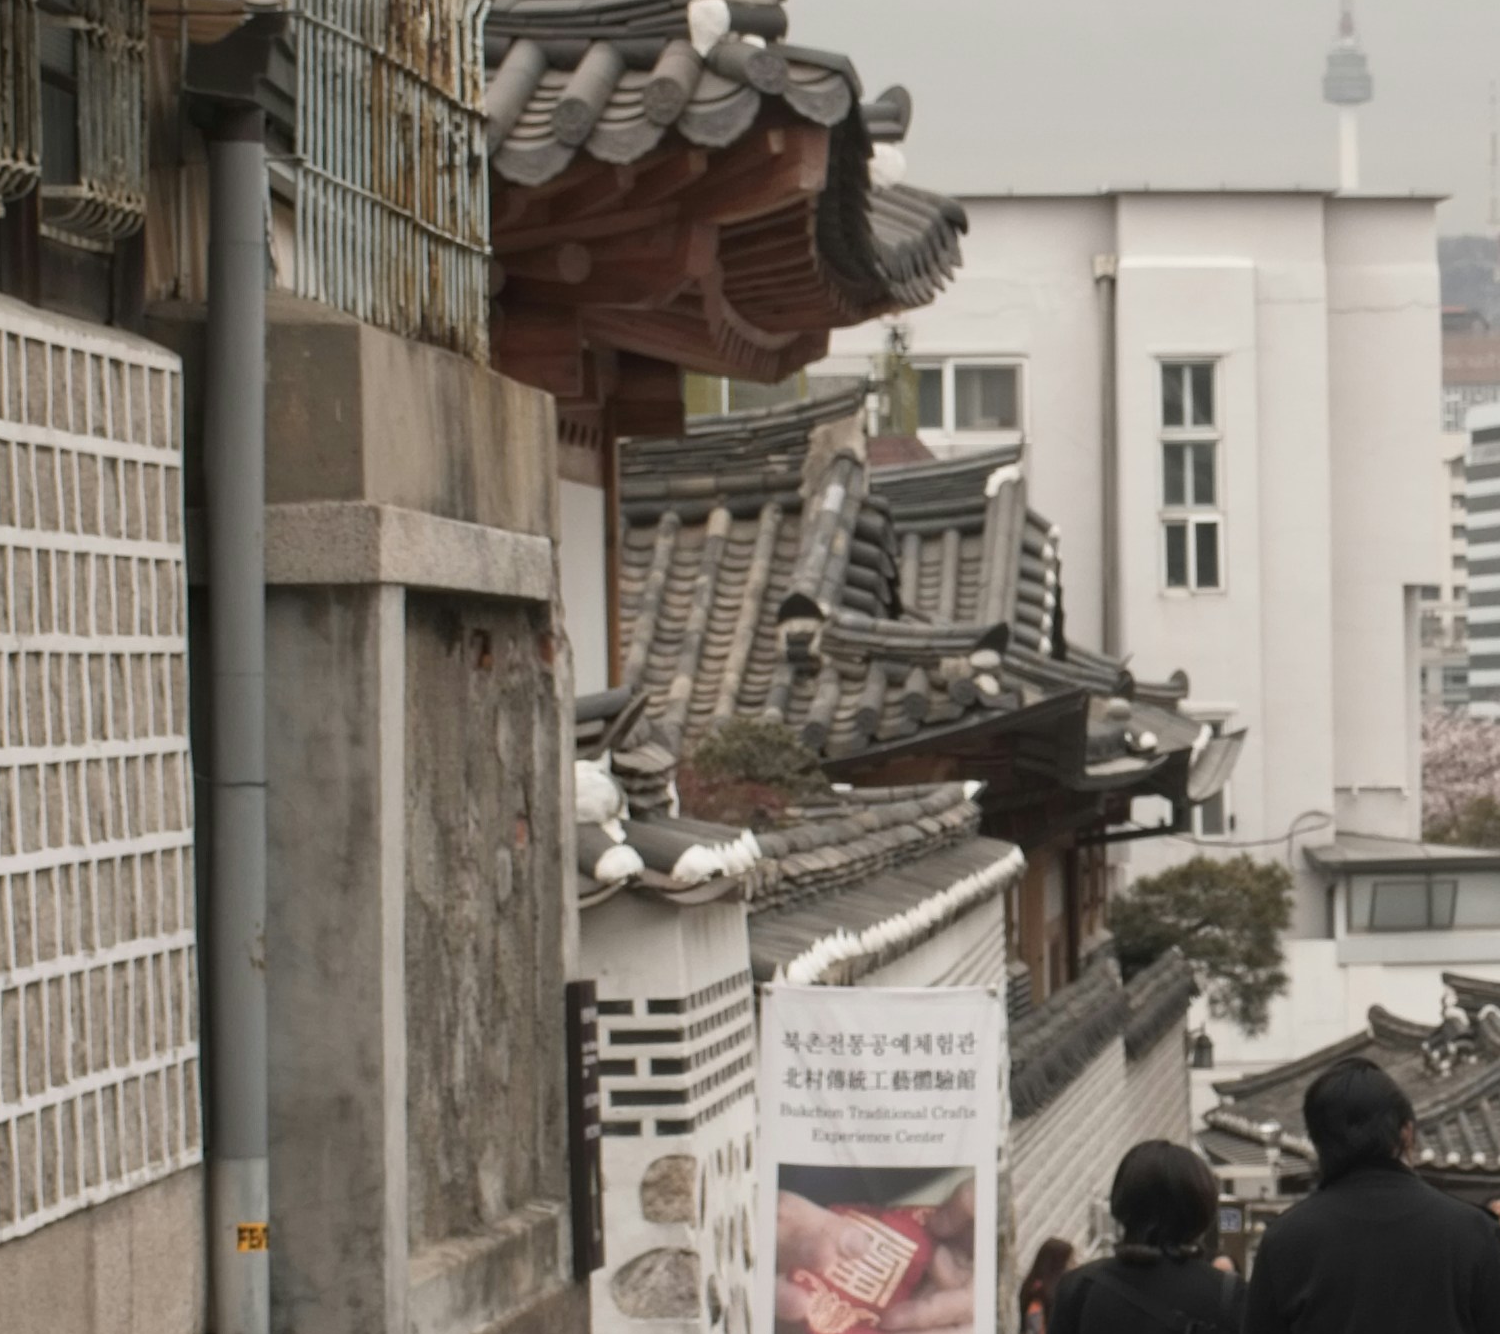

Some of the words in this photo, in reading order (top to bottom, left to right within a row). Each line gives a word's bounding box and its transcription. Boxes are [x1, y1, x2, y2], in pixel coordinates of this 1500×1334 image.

[780, 1102, 844, 1118] Bukchon
[849, 1105, 928, 1120] Traditional
[931, 1106, 977, 1120] Crafts
[812, 1128, 892, 1144] Experience
[895, 1130, 945, 1144] Center
